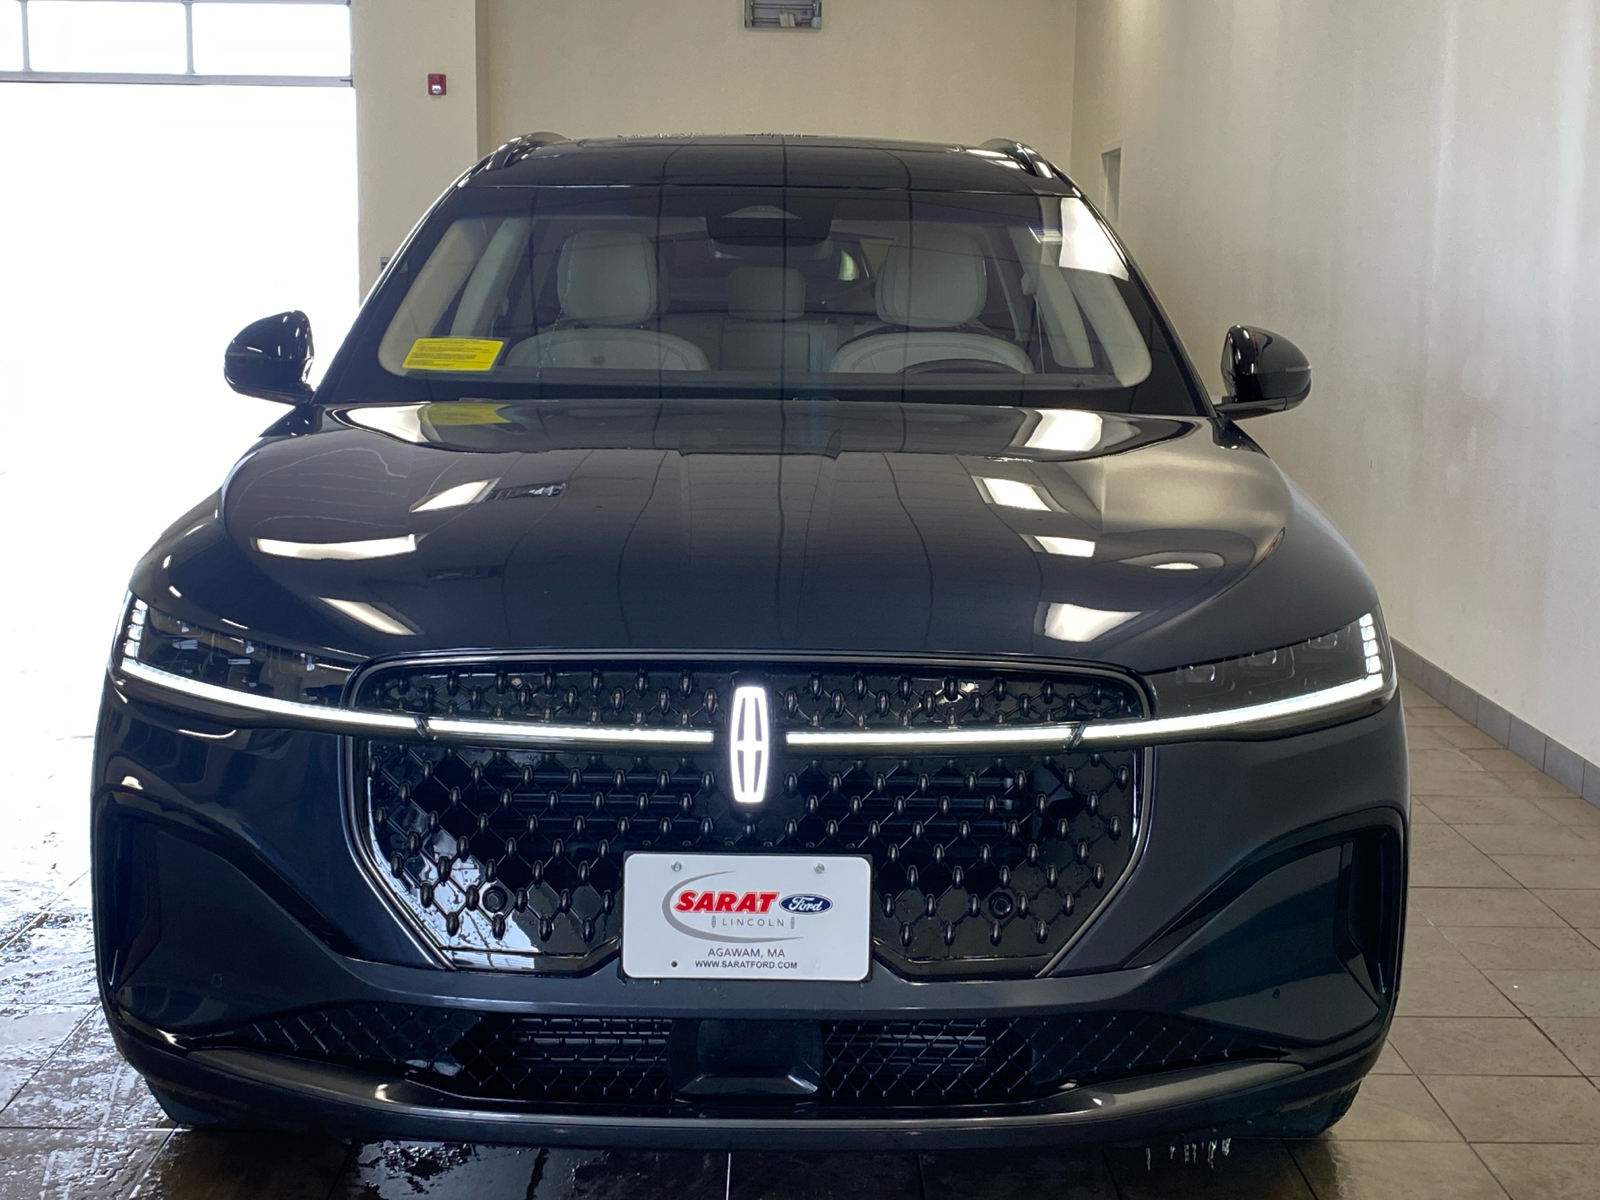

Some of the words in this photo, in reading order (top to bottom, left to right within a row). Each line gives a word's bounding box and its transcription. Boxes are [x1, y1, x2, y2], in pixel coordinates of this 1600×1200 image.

[675, 890, 779, 913] SARAT
[787, 895, 825, 912] Ford
[722, 917, 785, 927] LINCOLN
[707, 948, 764, 959] AGAWAM,
[767, 949, 786, 958] MA
[694, 960, 798, 969] WWW.SARATFORD.COM
